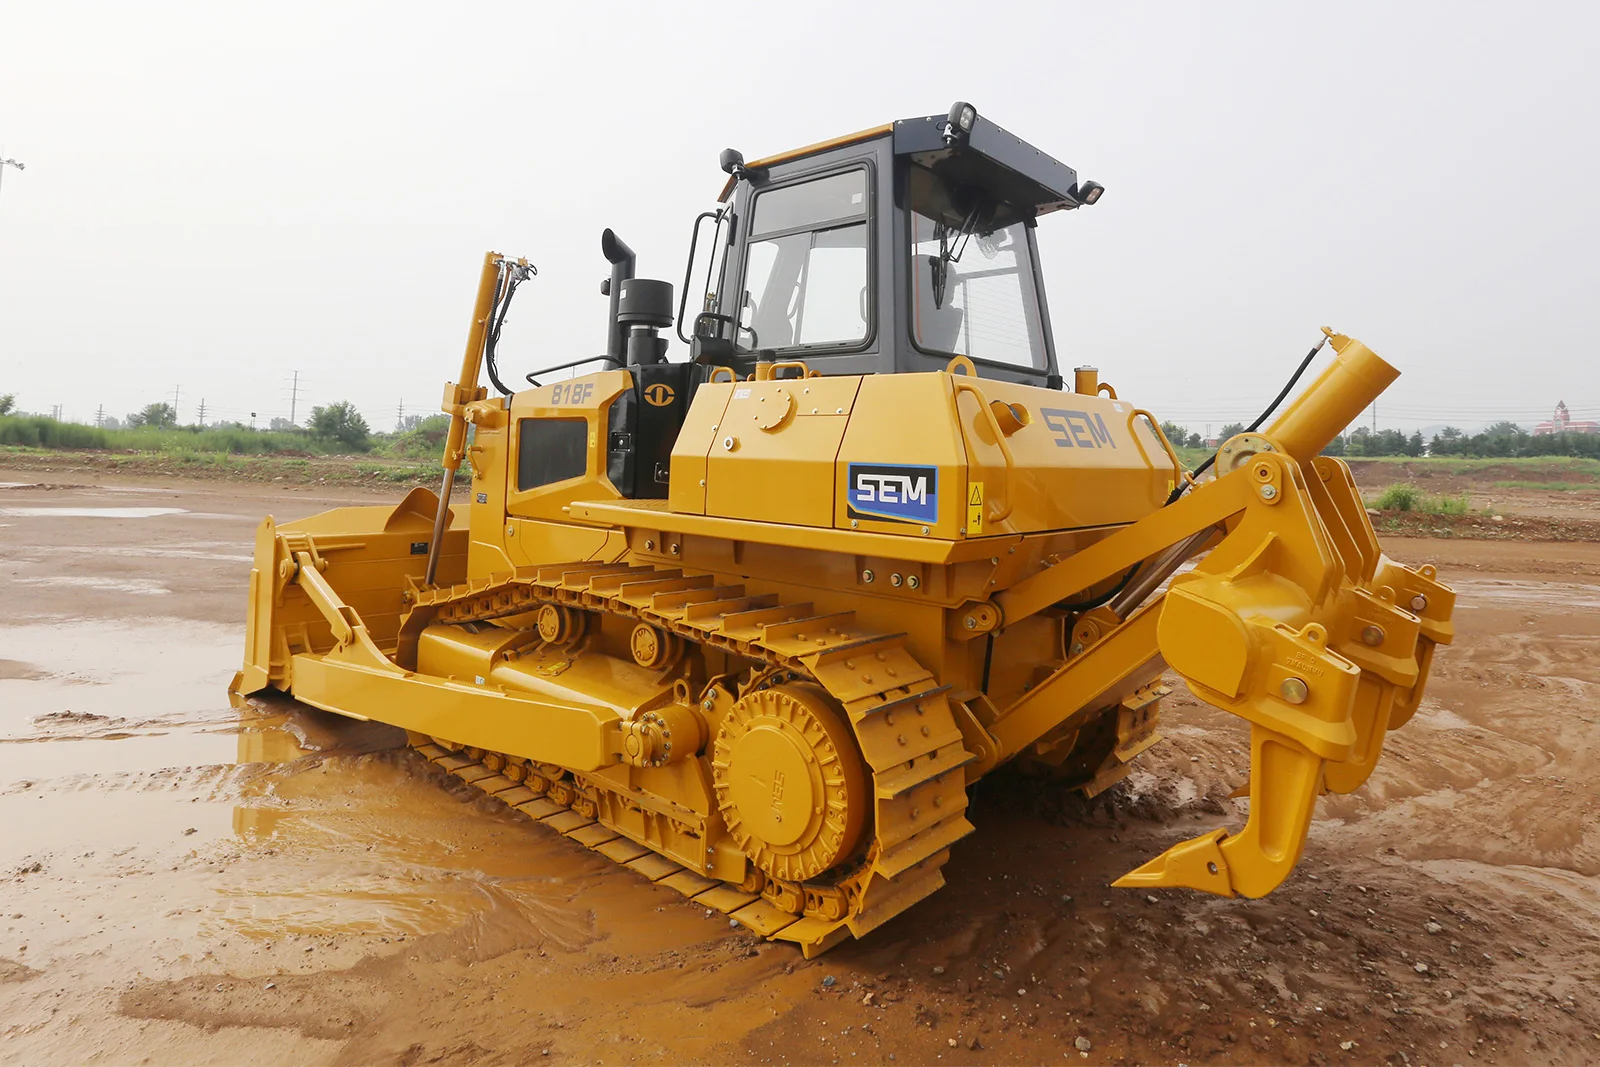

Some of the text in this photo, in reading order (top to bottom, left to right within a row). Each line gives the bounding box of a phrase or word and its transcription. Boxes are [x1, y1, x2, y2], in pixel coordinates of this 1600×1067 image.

[551, 383, 594, 405] 818F
[1040, 407, 1117, 449] SEM
[857, 473, 927, 506] SEM
